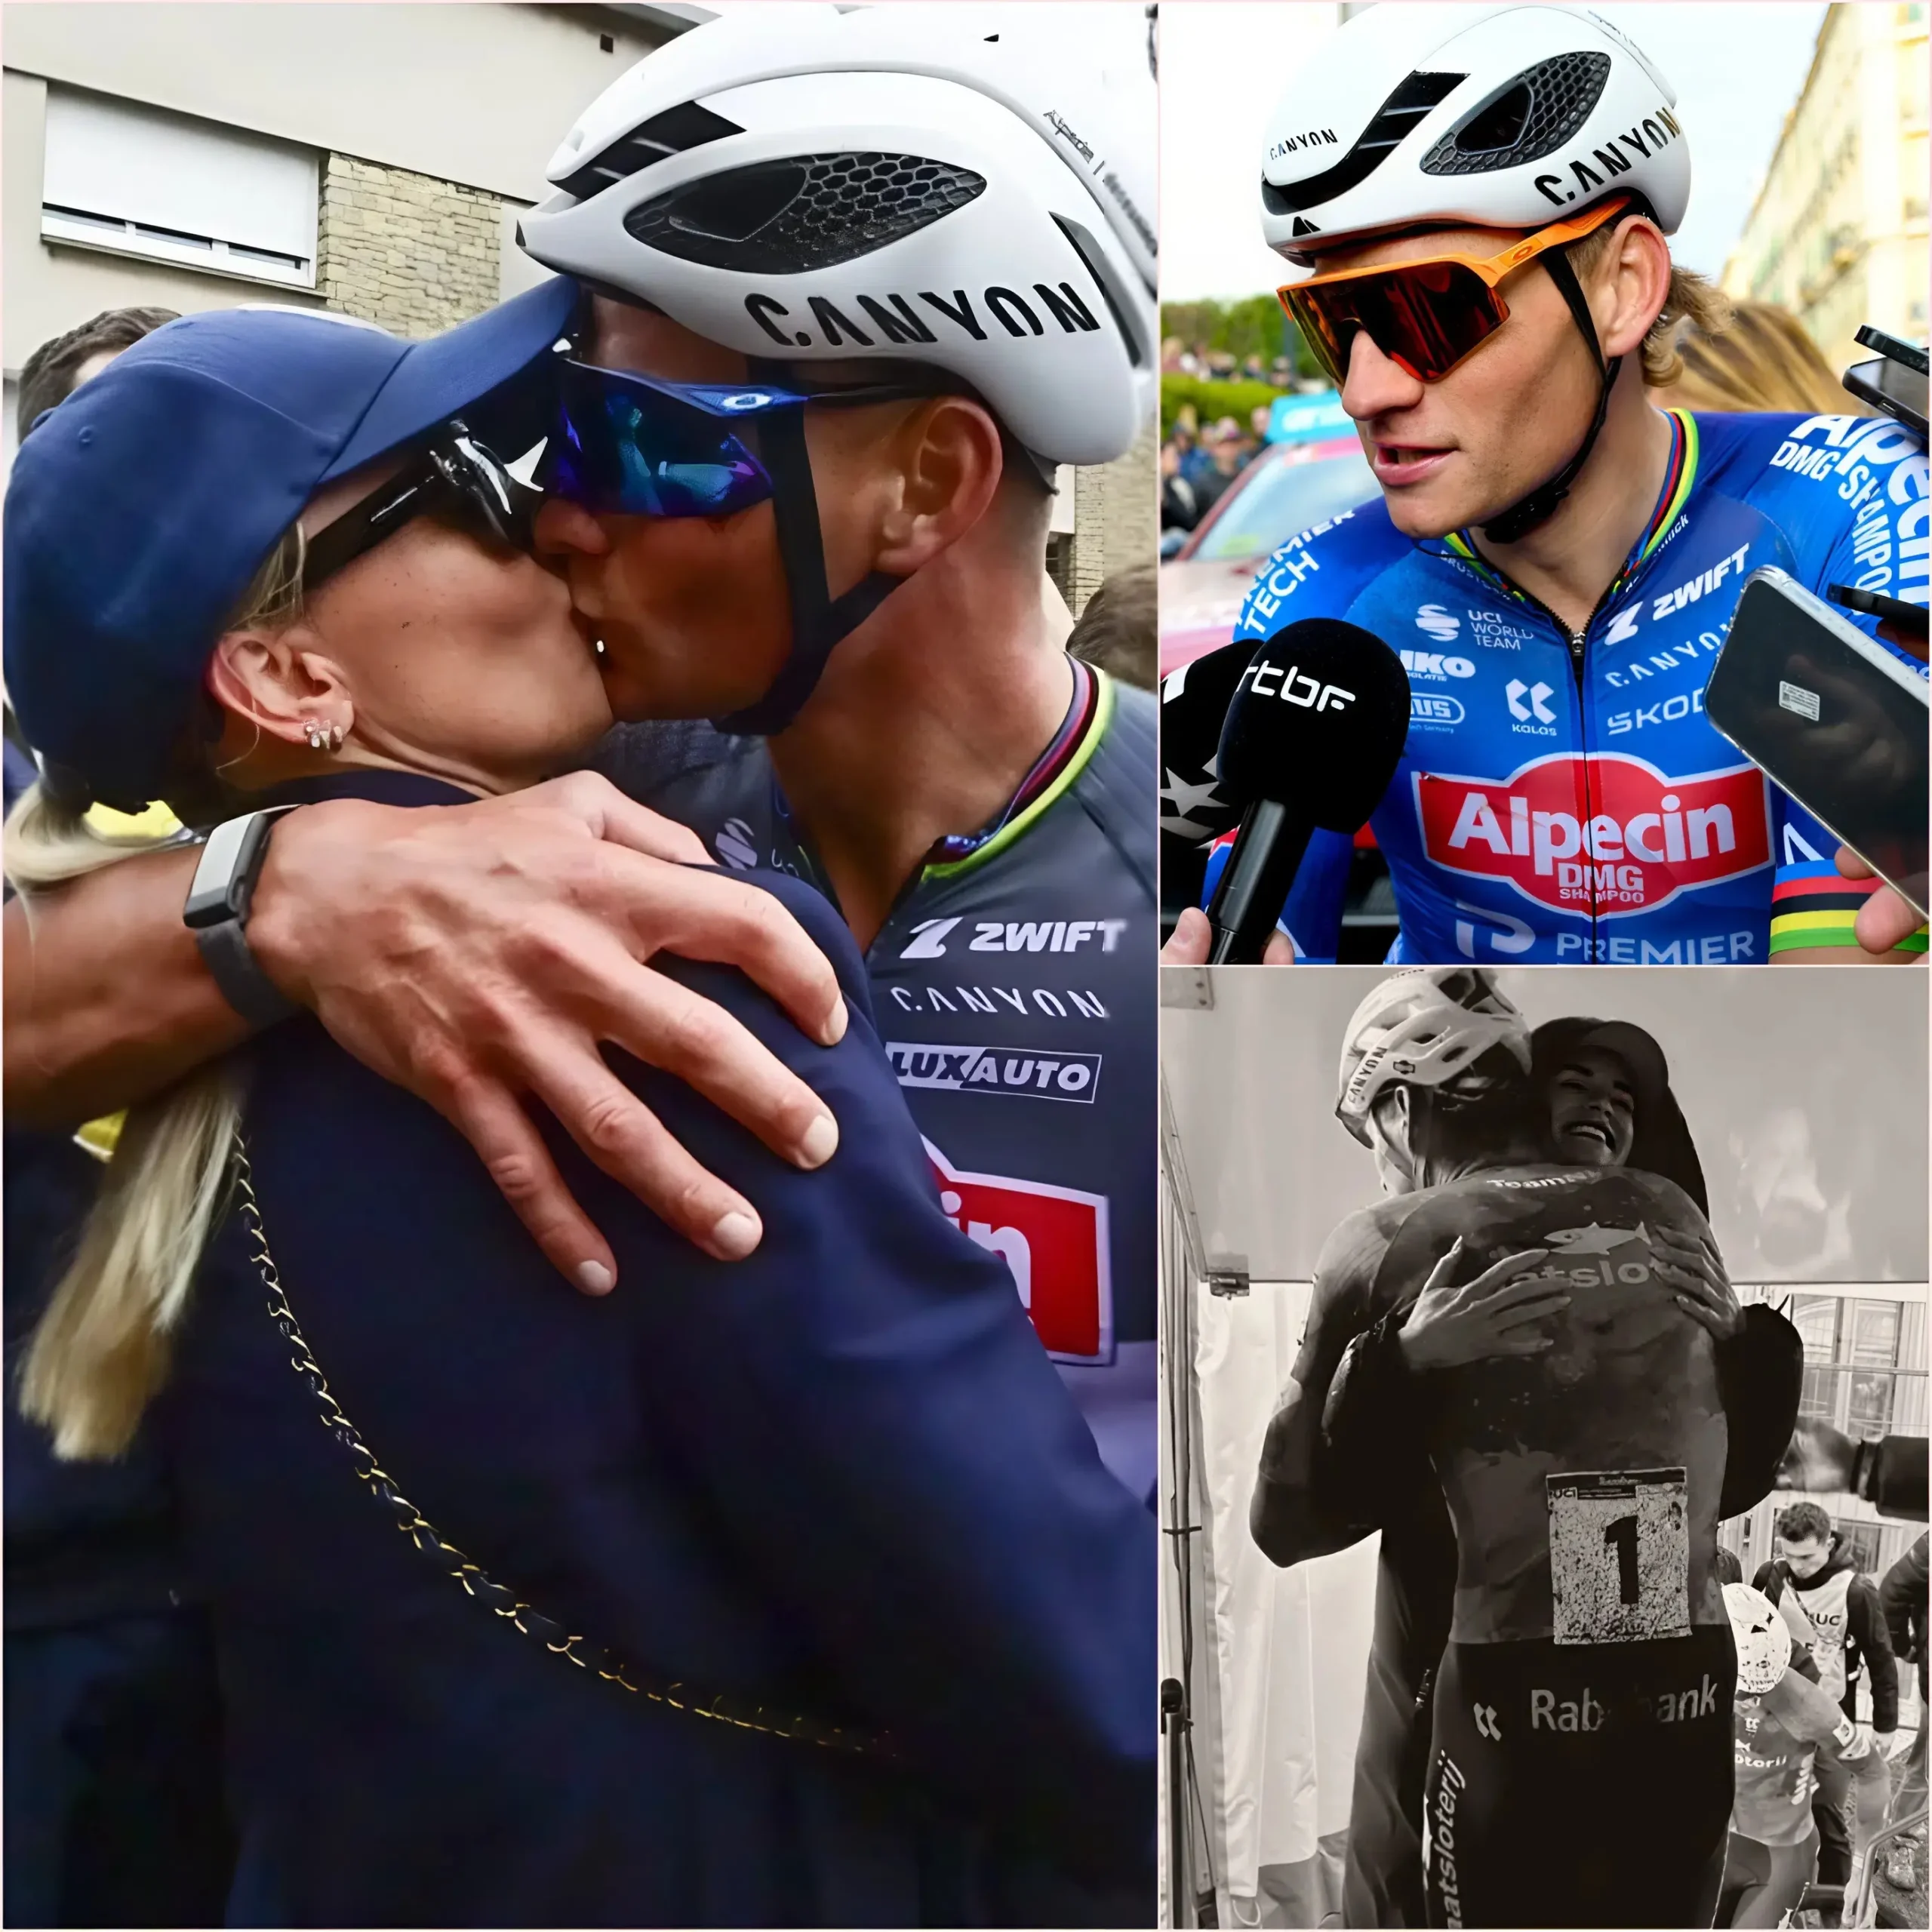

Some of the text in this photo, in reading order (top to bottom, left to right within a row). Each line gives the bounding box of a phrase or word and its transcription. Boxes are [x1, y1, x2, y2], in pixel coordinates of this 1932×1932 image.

[1269, 128, 1339, 161] CANYON
[1534, 106, 1682, 207] CANYON
[744, 281, 1101, 347] CANYON
[1769, 441, 1838, 481] DMG
[1243, 549, 1321, 635] TECH
[1652, 543, 1750, 621] ZWIFT
[1467, 609, 1503, 624] UCI
[1469, 622, 1534, 640] WORLD
[1473, 634, 1521, 651] TEAM
[1400, 650, 1476, 678] IKO
[1235, 659, 1356, 712] rtbf
[1411, 698, 1452, 718] US
[1607, 687, 1705, 736] SKOD
[1447, 791, 1737, 876] Alpecin
[1557, 862, 1644, 892] DMG
[1558, 888, 1645, 904] SHAMPOO
[969, 918, 1128, 953] ZWIFT
[1555, 930, 1755, 965] PREMIER
[890, 986, 1110, 1019] CANYON
[1604, 1515, 1641, 1605] 1
[1531, 1673, 1718, 1733] Rabank
